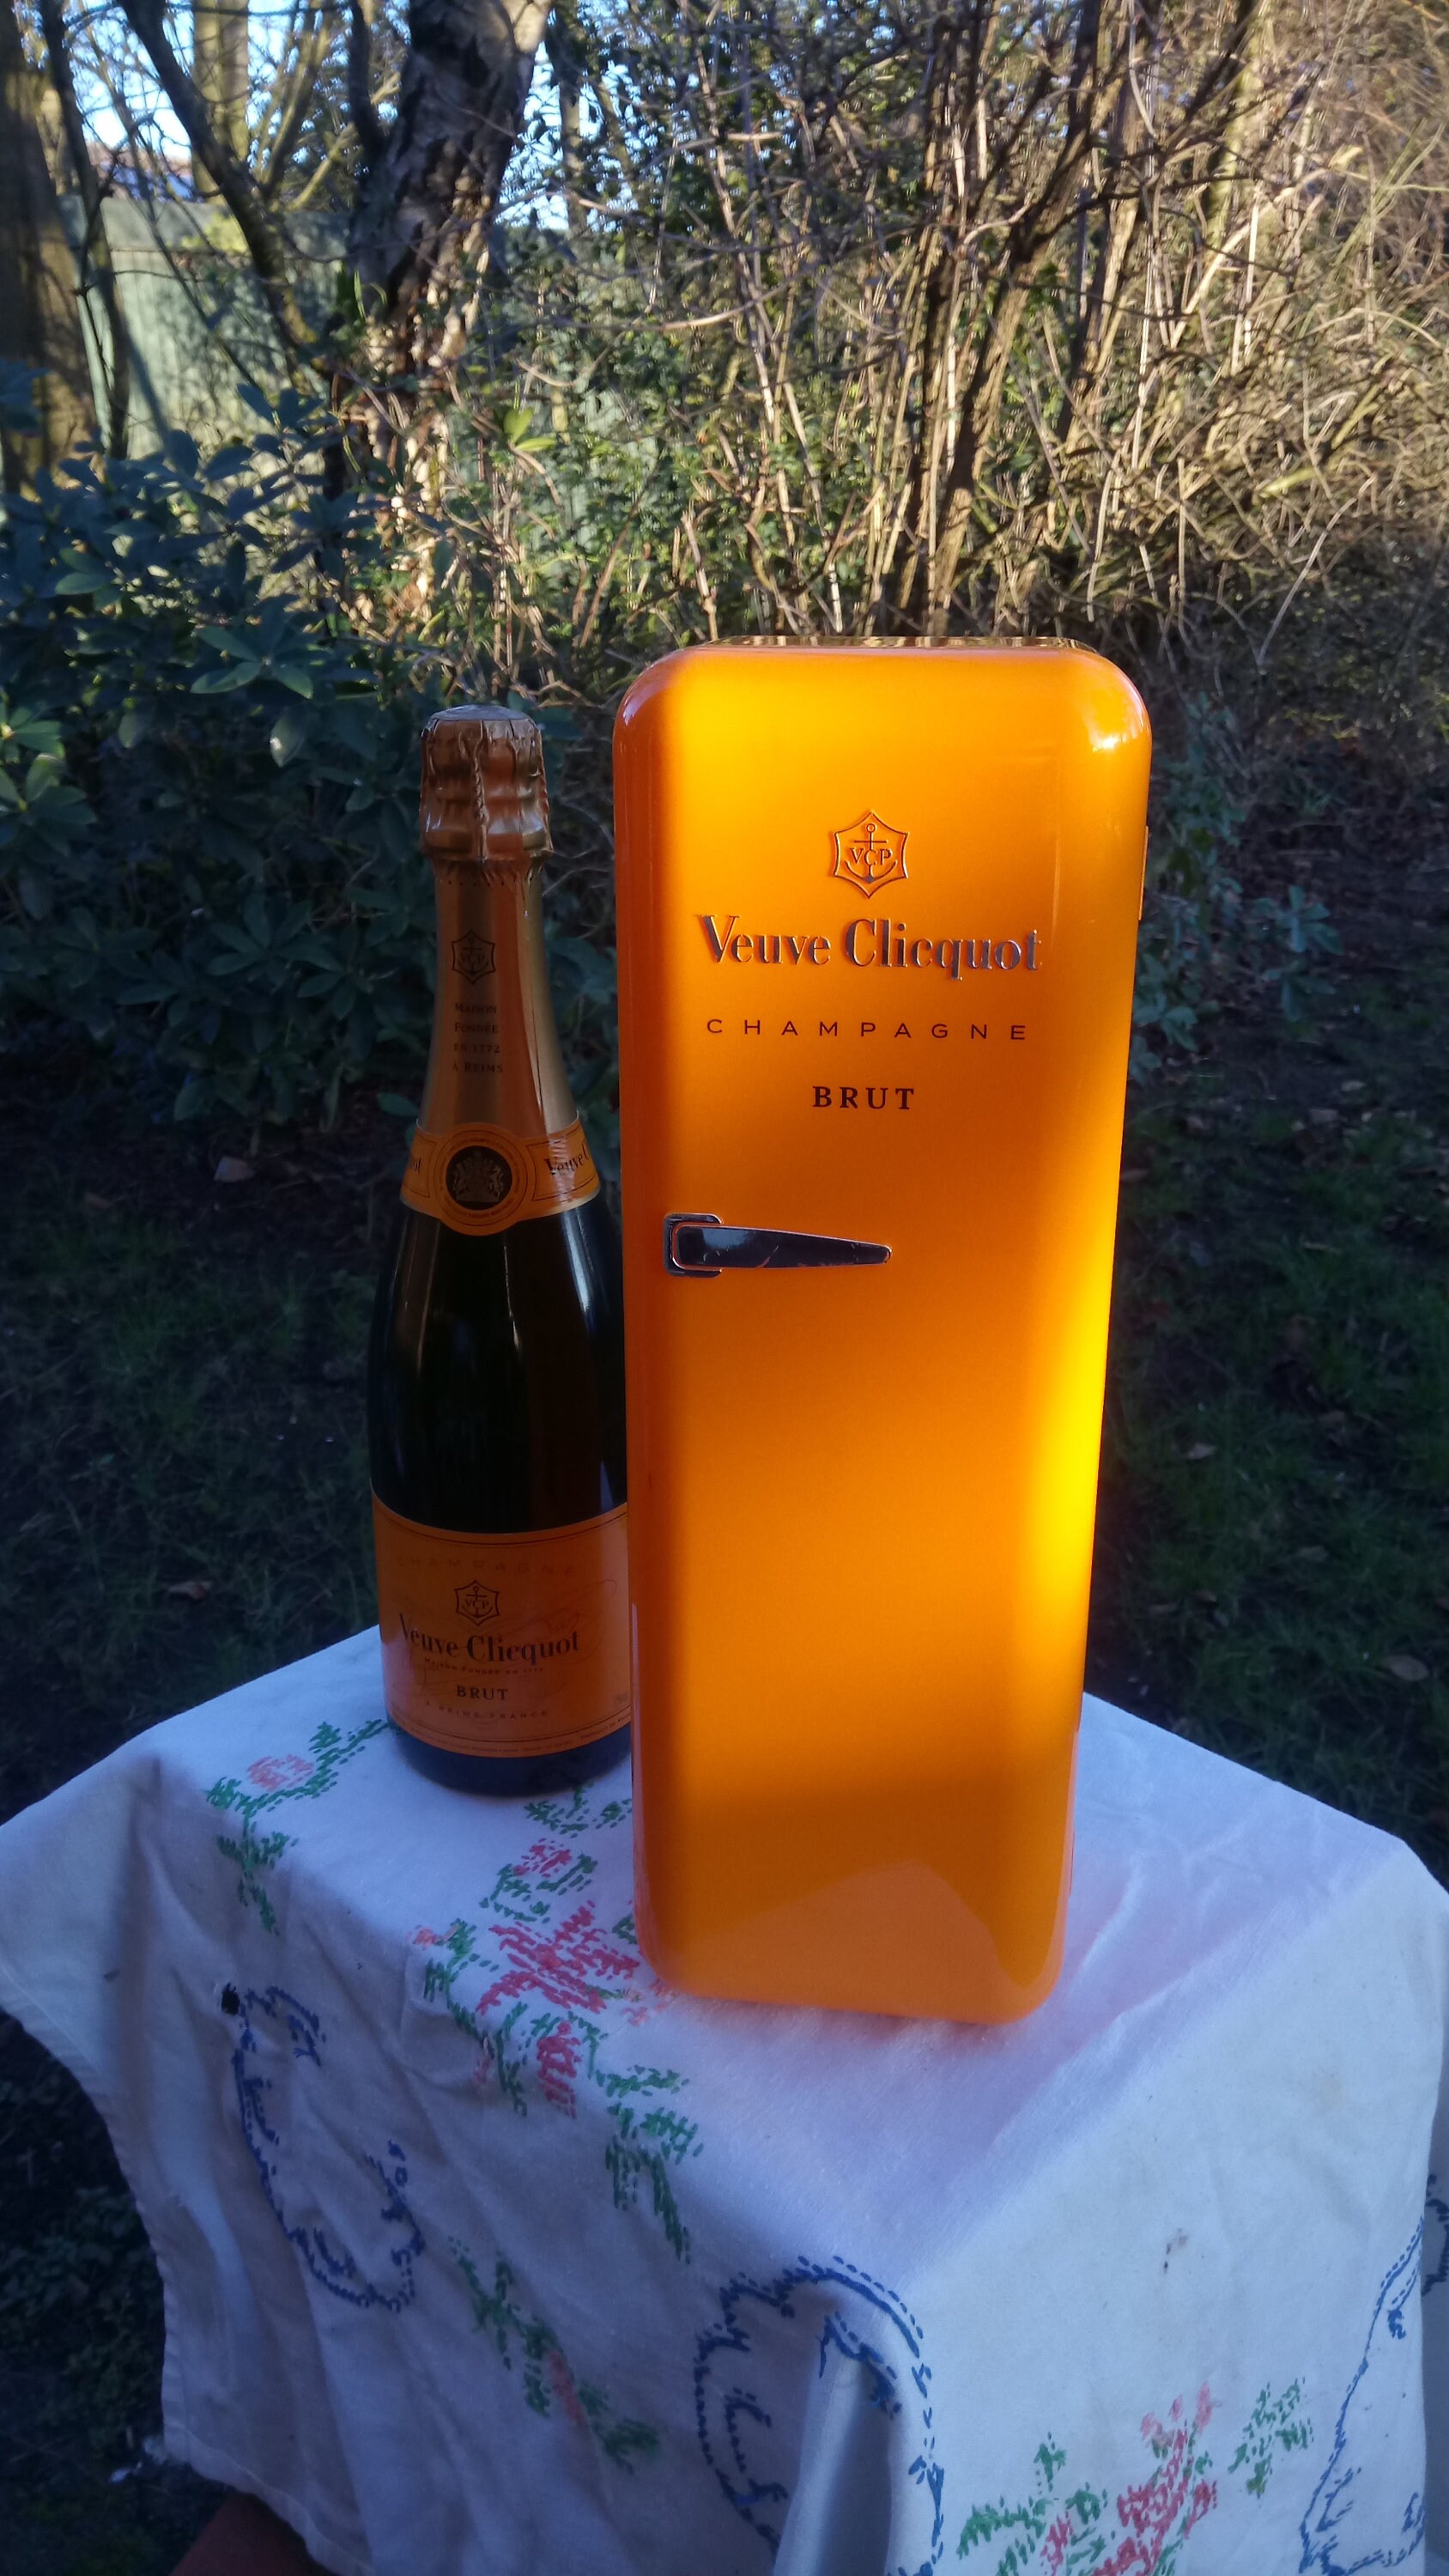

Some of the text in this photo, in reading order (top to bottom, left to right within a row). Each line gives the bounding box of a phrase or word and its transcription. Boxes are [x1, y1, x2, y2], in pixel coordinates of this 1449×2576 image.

[849, 847, 894, 866] VCP
[700, 914, 1042, 981] Veuve Clicquot
[706, 1018, 1027, 1041] CHAMPAGNE
[473, 1044, 500, 1054] 1772
[464, 1062, 504, 1073] REIMS
[812, 1086, 915, 1110] BRUT
[399, 1613, 579, 1666] Veuve Clicquot
[457, 1686, 508, 1701] BRUT
